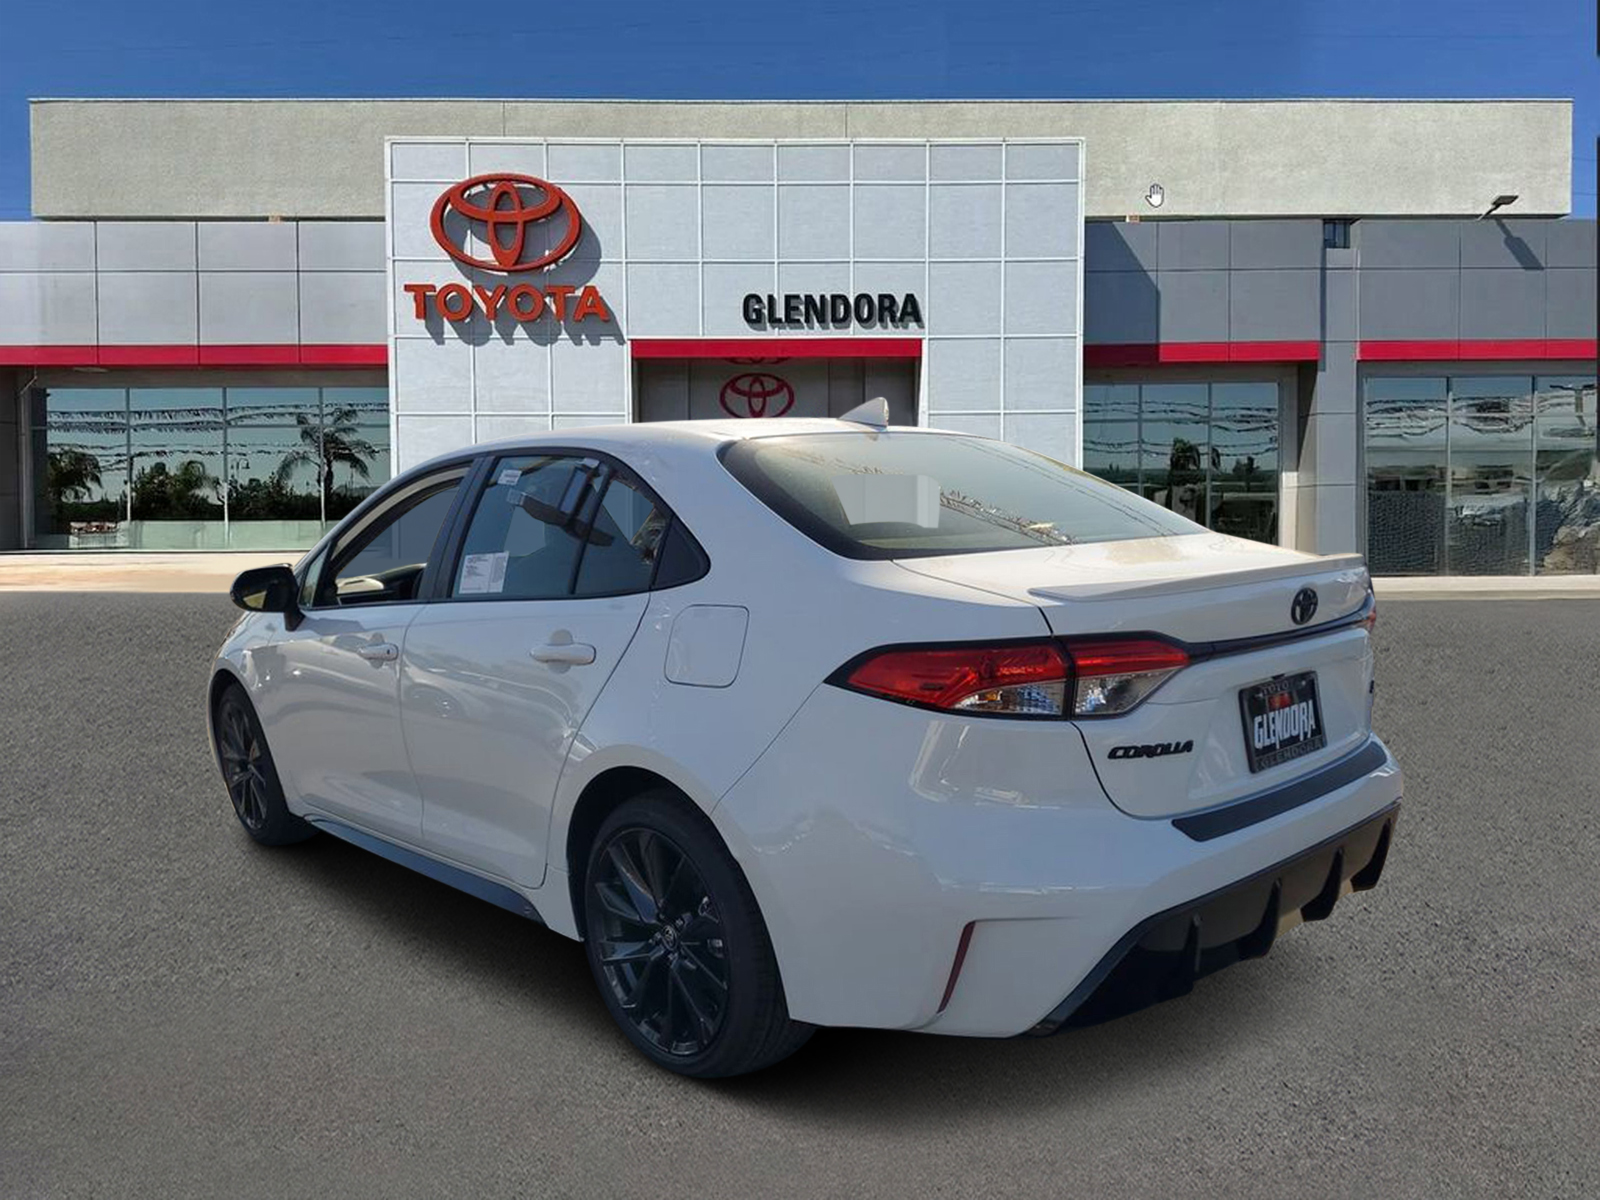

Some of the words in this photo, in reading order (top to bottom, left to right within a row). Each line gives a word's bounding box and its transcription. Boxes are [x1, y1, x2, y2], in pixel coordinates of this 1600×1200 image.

[404, 283, 610, 322] TOYOTA
[743, 293, 922, 325] GLENDORA
[1254, 699, 1316, 750] GLENDORA
[1107, 739, 1194, 759] COROLLA
